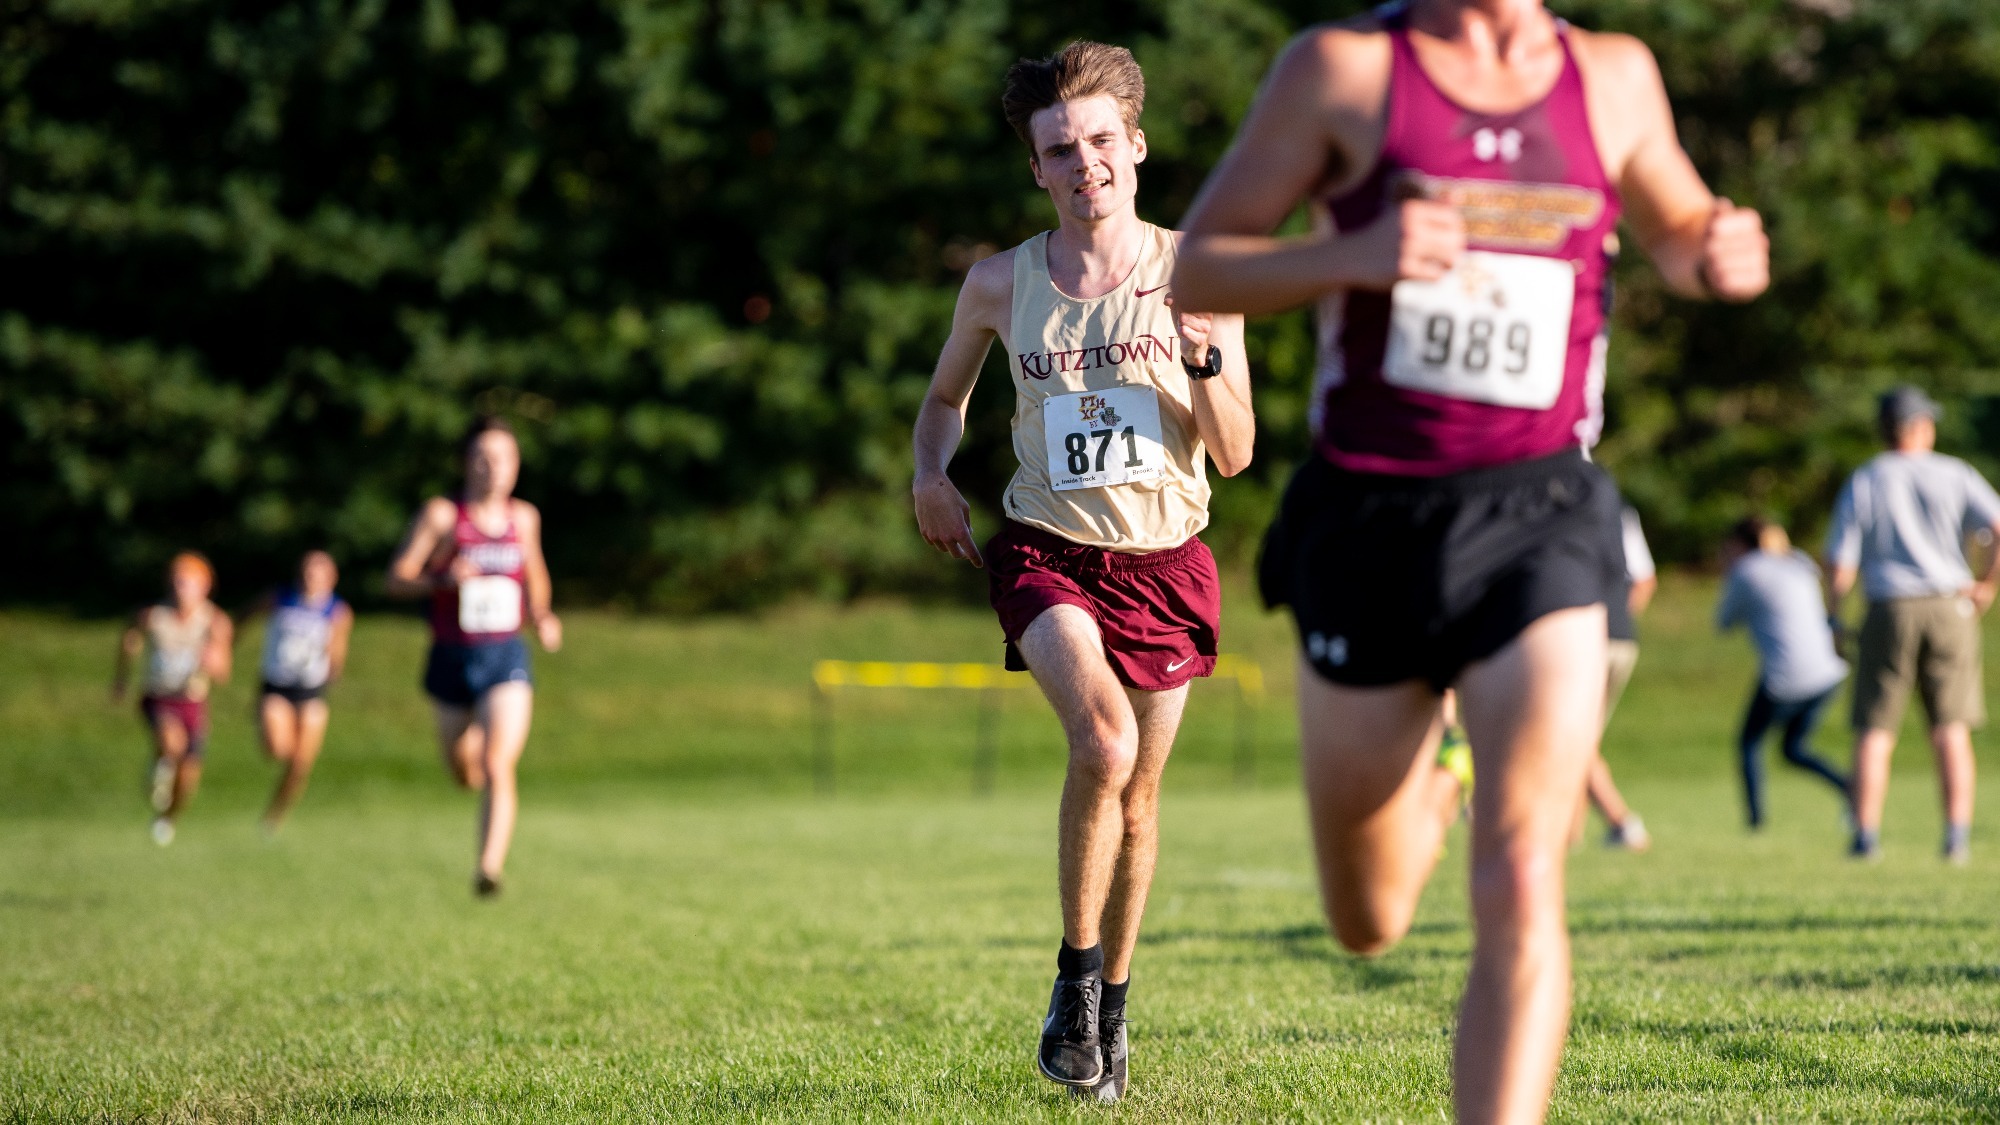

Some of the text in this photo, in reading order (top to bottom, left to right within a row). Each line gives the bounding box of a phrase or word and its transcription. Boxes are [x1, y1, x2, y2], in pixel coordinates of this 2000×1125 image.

[1018, 334, 1174, 380] KUTZTOWN
[1421, 314, 1531, 375] 989
[1080, 408, 1097, 420] XC
[1065, 425, 1143, 475] 871
